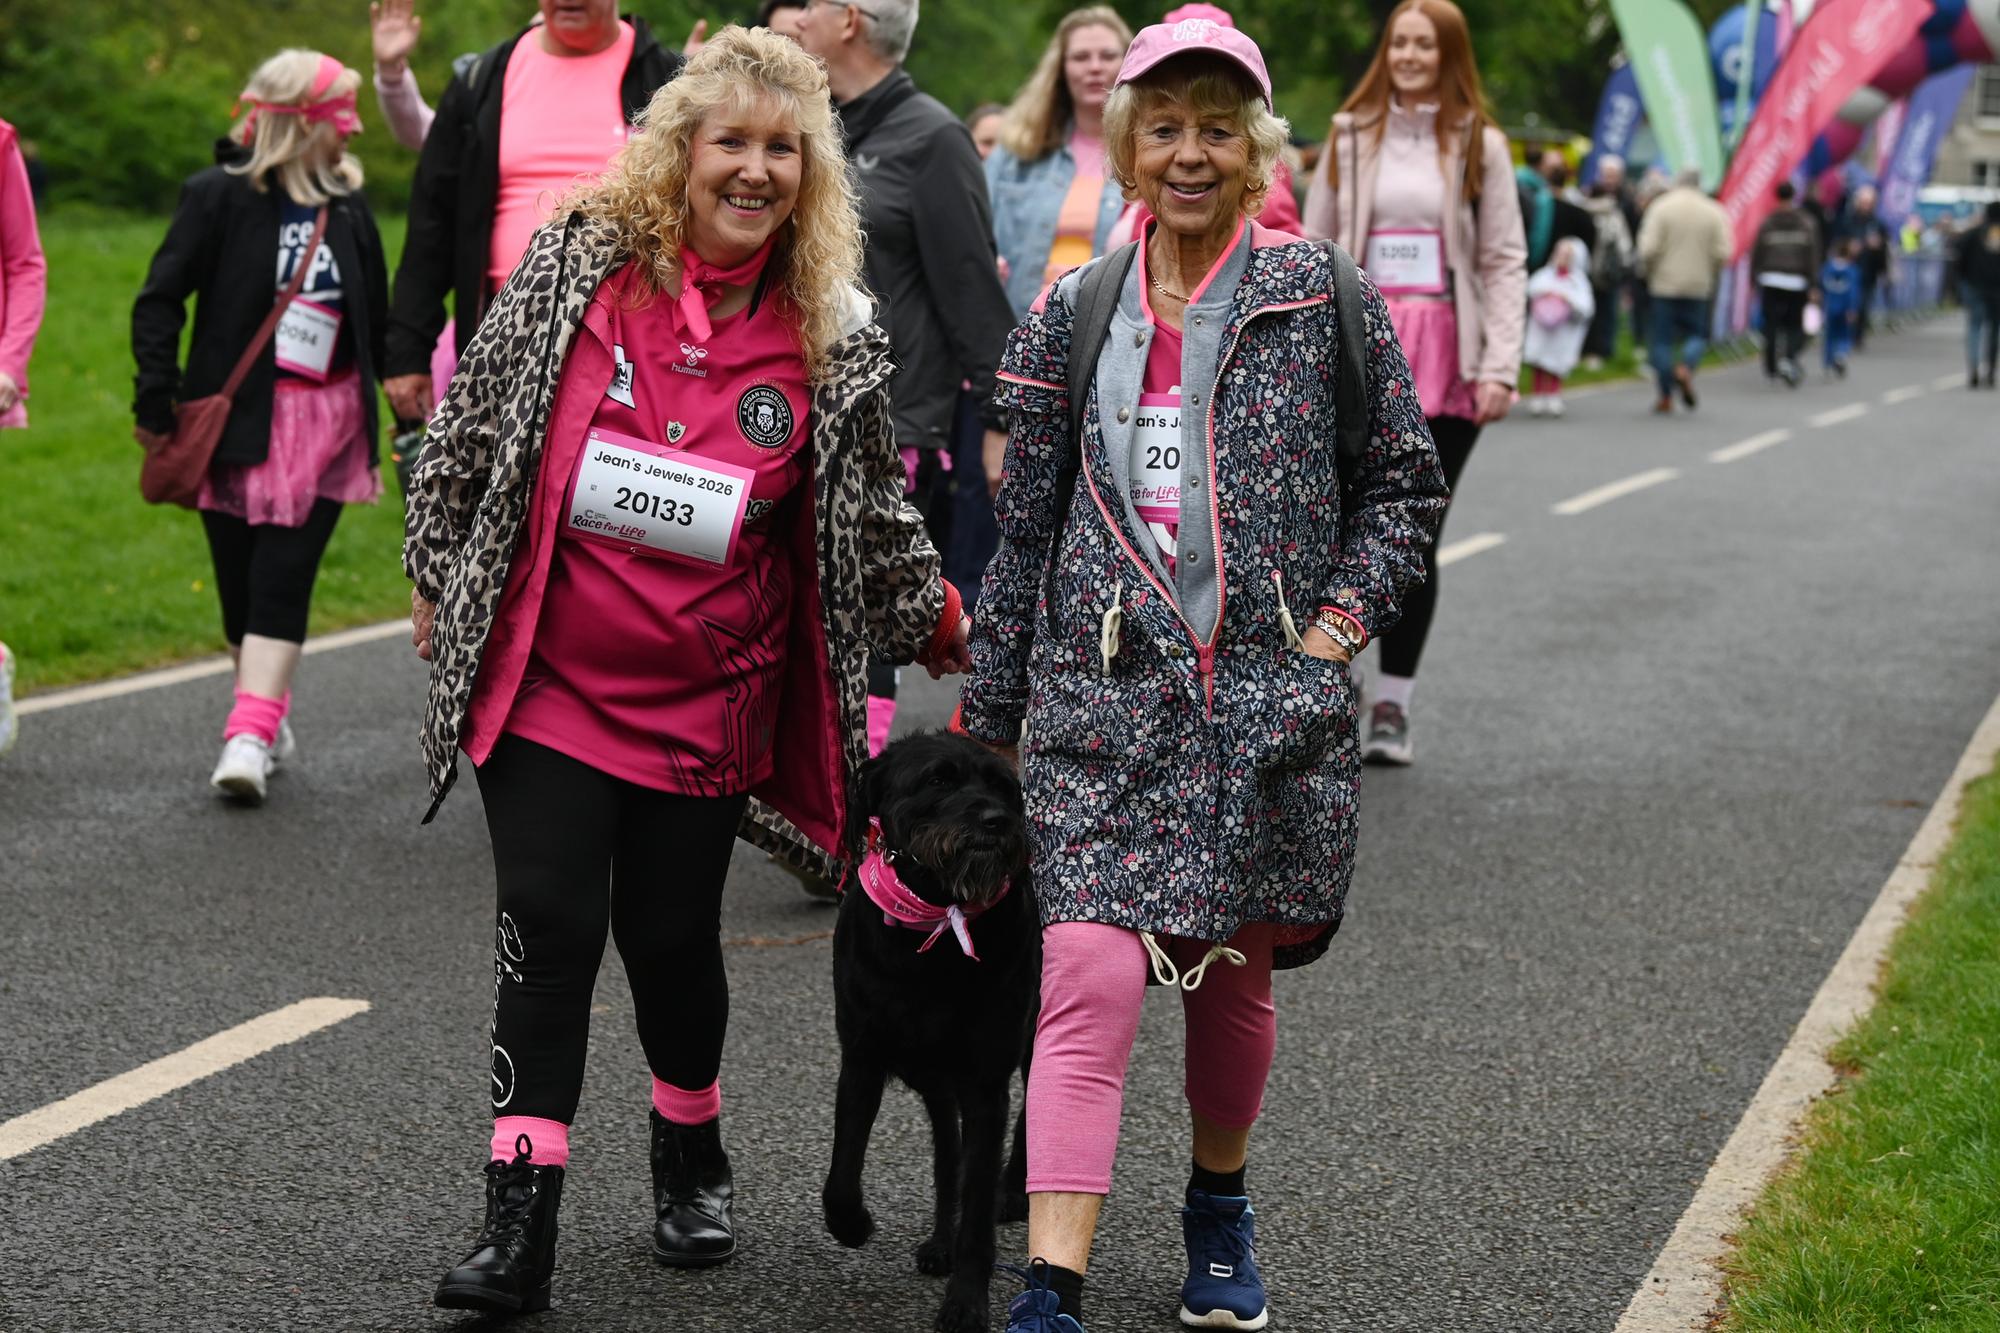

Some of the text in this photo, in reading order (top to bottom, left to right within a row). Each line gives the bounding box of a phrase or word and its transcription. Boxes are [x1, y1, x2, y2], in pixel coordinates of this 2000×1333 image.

[671, 362, 708, 378] hummel
[743, 391, 788, 417] WIGAN WARRIORS
[1170, 416, 1182, 428] J
[1146, 445, 1181, 470] 20
[594, 451, 733, 496] Jean's Jewels 2026
[1141, 487, 1156, 500] for
[613, 487, 695, 527] 20133
[572, 514, 603, 529] Race
[603, 522, 620, 532] for
[618, 524, 647, 540] Life
